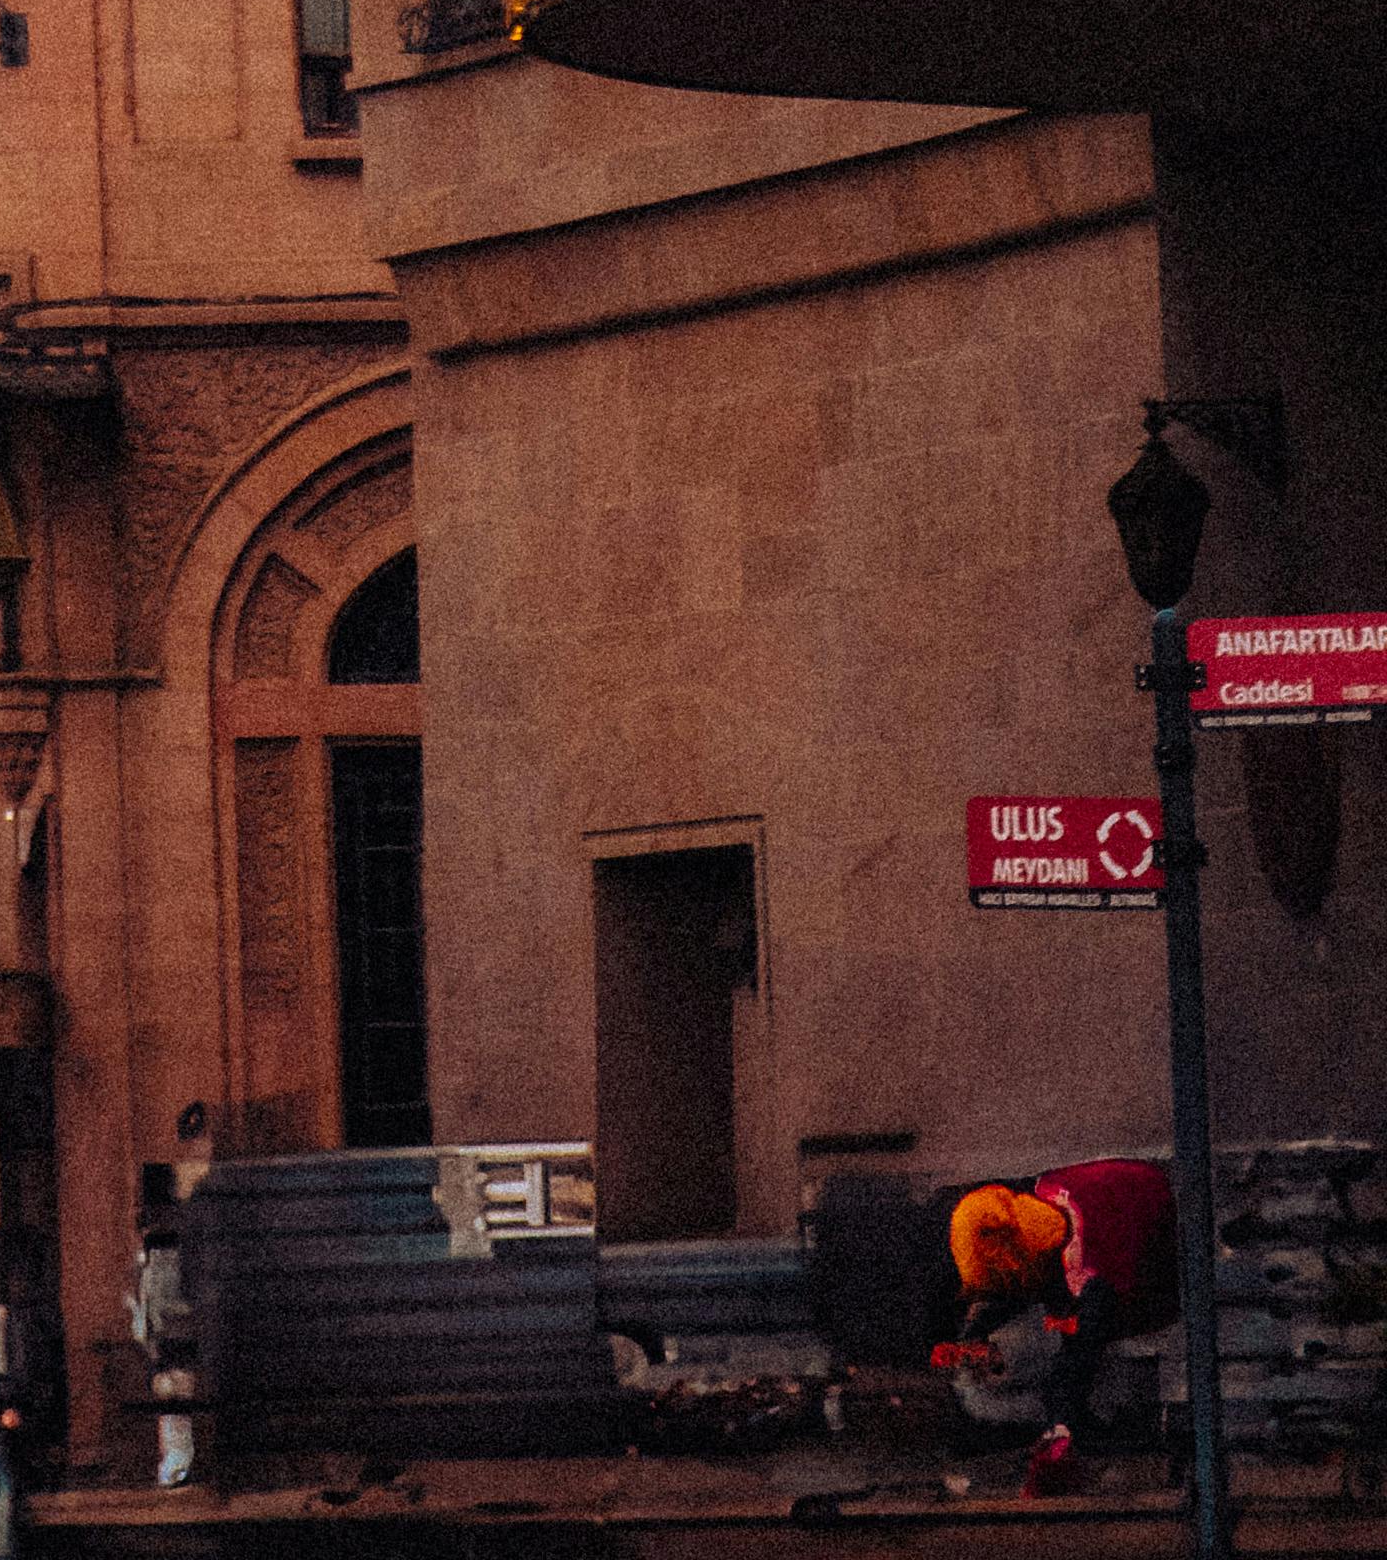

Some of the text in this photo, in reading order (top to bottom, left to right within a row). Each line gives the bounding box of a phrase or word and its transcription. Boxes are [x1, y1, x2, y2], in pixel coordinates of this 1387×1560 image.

[1219, 676, 1315, 705] Caddesi
[990, 805, 1065, 842] ULUS
[991, 857, 1090, 885] MEYDANI
